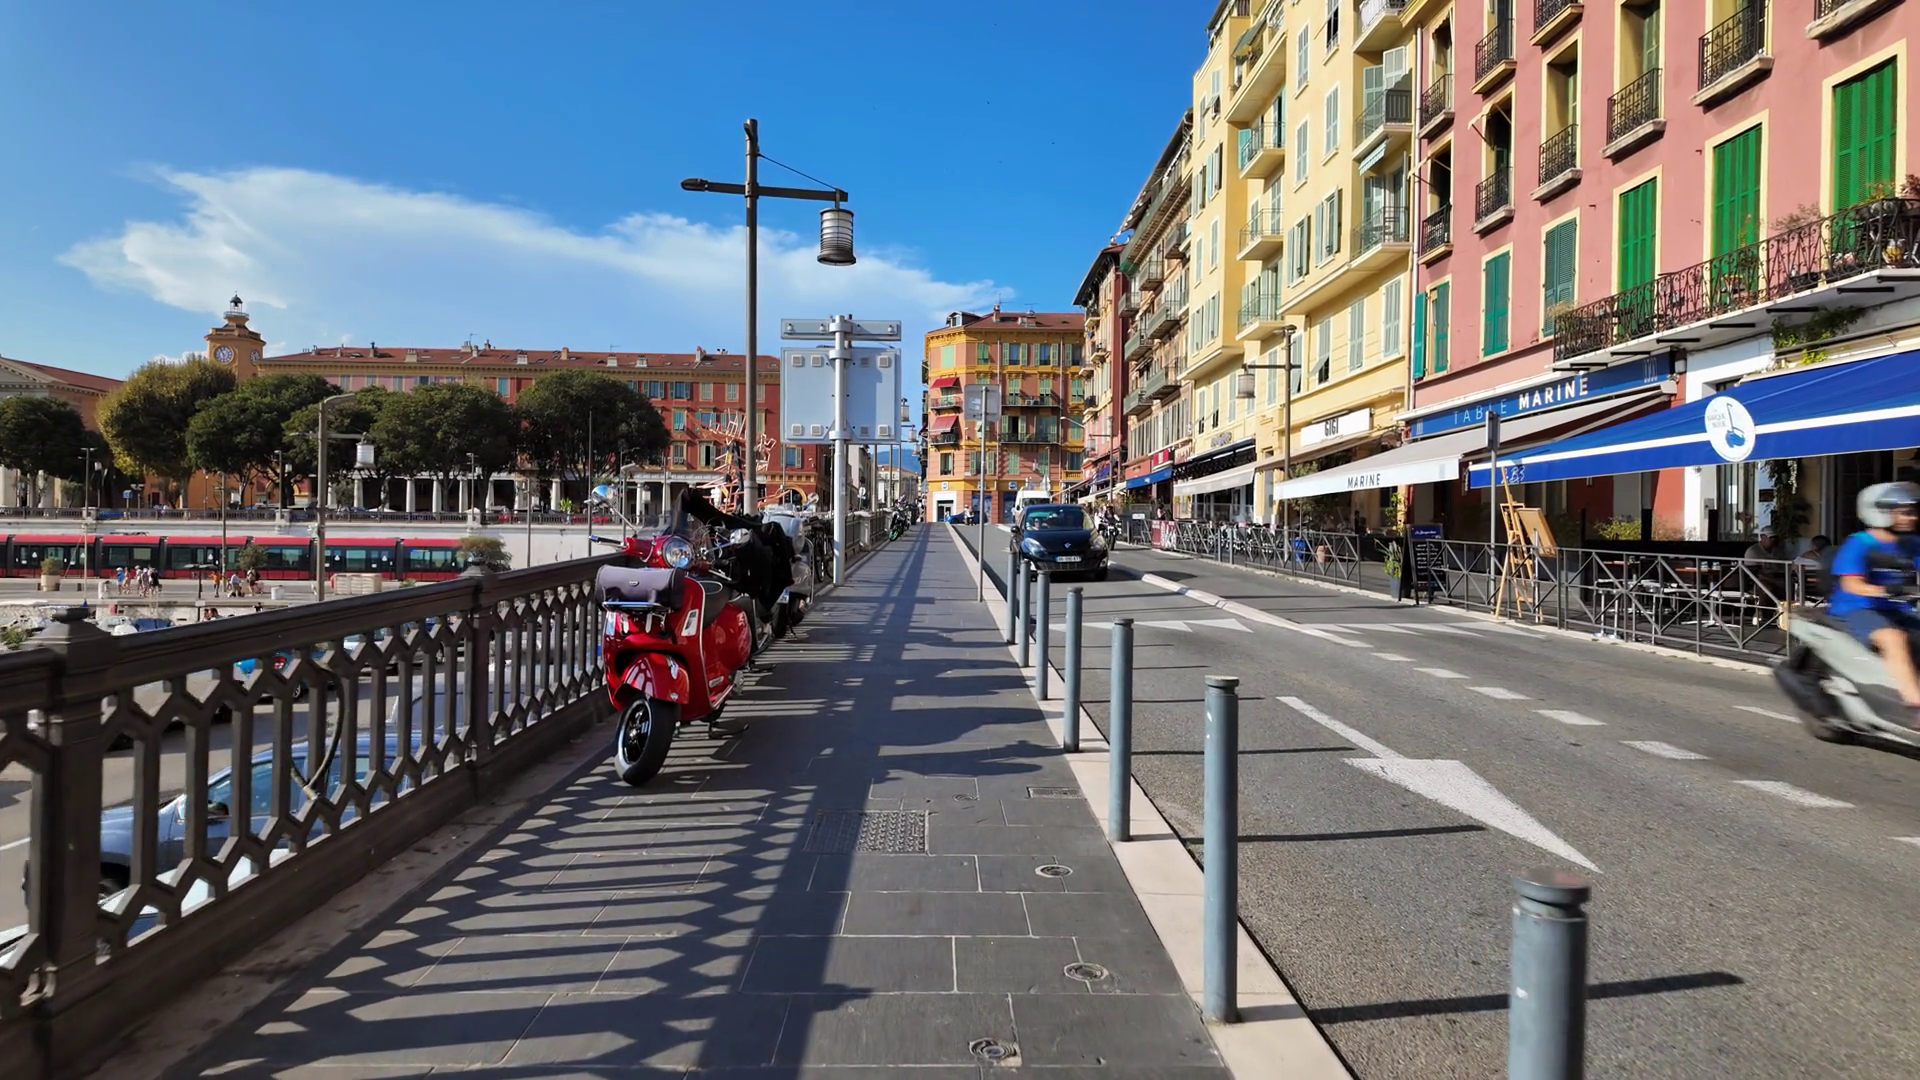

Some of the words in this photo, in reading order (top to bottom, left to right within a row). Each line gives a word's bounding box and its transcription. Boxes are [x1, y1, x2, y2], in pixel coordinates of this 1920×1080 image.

[1518, 377, 1589, 411] MARINE
[1324, 418, 1339, 437] GIGI
[1347, 473, 1381, 489] MARINE
